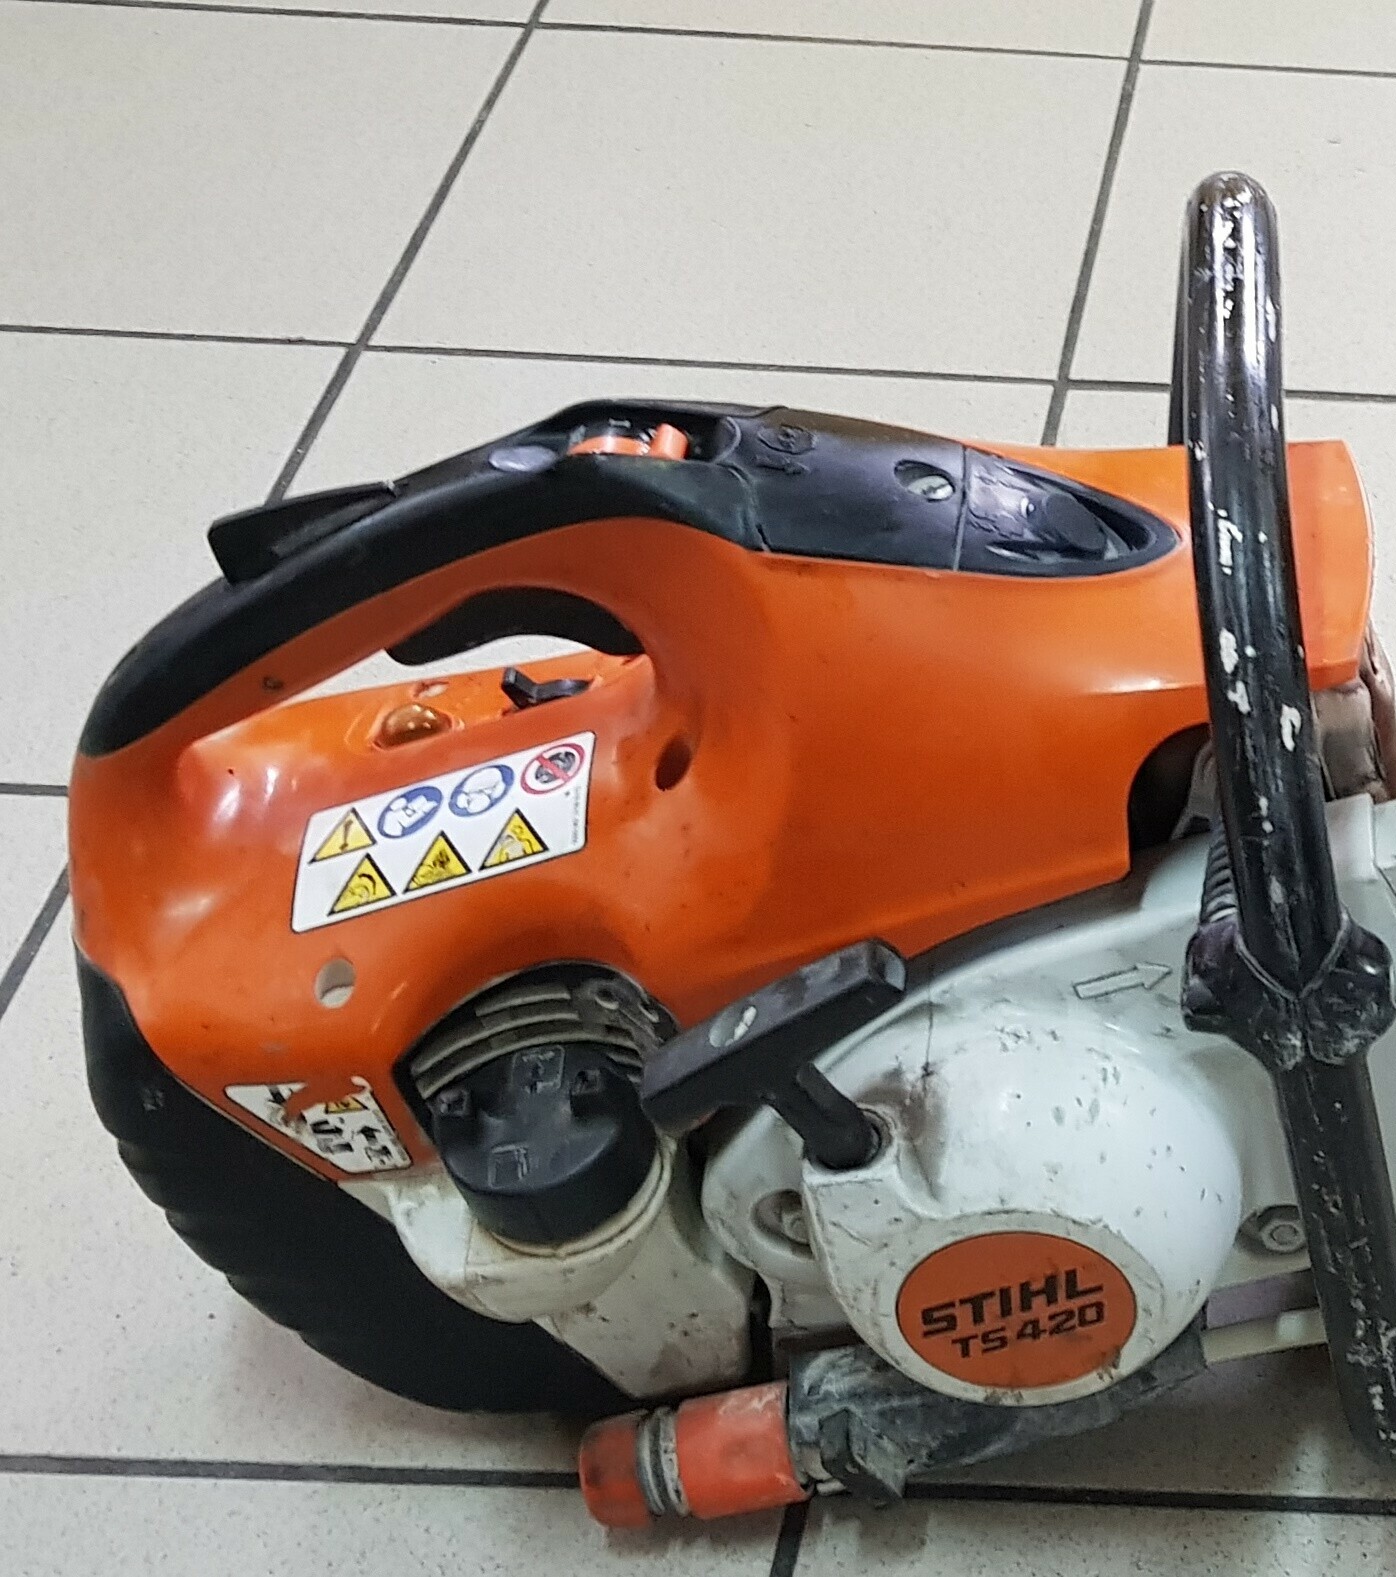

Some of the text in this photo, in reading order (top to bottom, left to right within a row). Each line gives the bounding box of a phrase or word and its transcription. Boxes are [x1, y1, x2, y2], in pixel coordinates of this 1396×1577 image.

[921, 1268, 1104, 1338] STIHL
[952, 1301, 1105, 1358] TS 420
